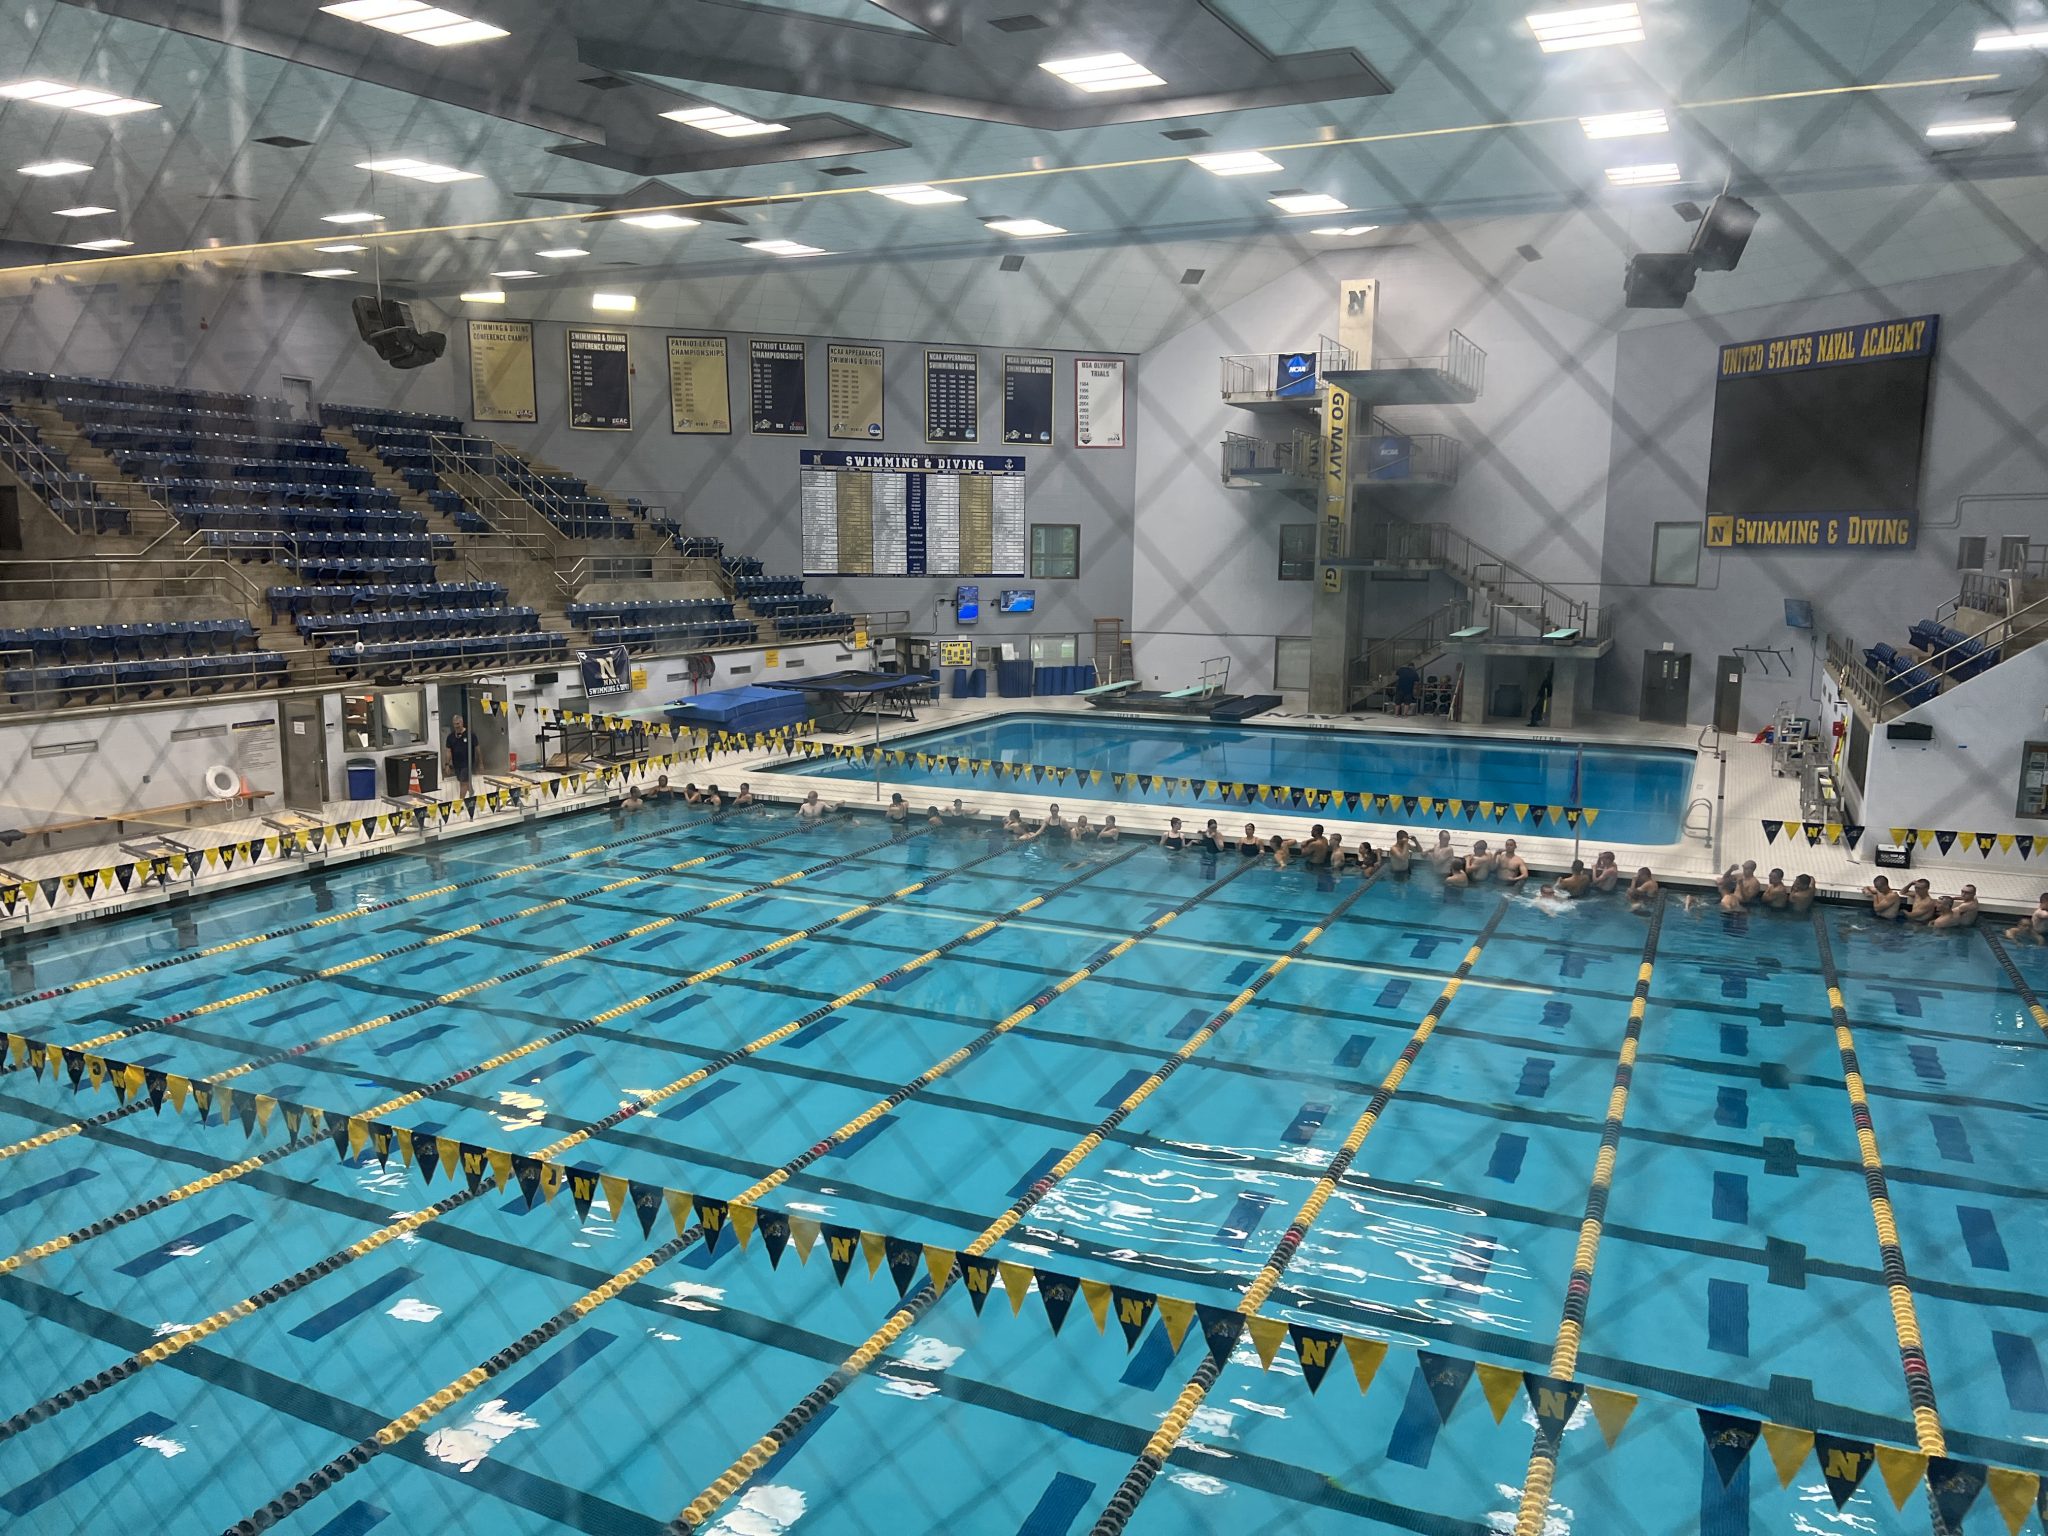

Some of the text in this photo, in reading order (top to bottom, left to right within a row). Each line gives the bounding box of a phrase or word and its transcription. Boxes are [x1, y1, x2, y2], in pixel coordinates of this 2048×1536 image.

[472, 323, 503, 332] SWIMMING
[510, 325, 529, 333] DIVING
[473, 333, 529, 342] CONFERENCE CHAMPS
[571, 332, 601, 341] SWIMMING
[607, 334, 626, 343] DIVING
[571, 342, 626, 352] CONFERENCE CHAMPS
[671, 339, 723, 348] PATRIOT LEAGUE
[752, 342, 803, 351] PATRIOT LEAGUE
[1722, 320, 1927, 376] UNITED STATES NAVAL ACADEMY
[671, 349, 725, 357] CHAMPIONSHIPS
[752, 351, 804, 360] CHAMPIONSHIPS
[845, 349, 882, 358] APPEARANCES
[928, 353, 976, 362] NCAA APPEARANCES
[830, 356, 857, 364] SWIMMING
[1020, 357, 1052, 366] APPEARANCES
[929, 362, 954, 370] SWIMMING
[959, 363, 976, 371] DIVING
[1006, 365, 1031, 373] SWIMMING
[1288, 366, 1307, 374] NCAA
[1331, 392, 1345, 421] GO
[1329, 426, 1344, 481] NAVY
[845, 455, 919, 468] SWIMMING
[924, 458, 932, 468] &
[938, 458, 985, 470] DIVING
[1710, 516, 1910, 546] N SWIMMING & DIVING
[596, 656, 617, 679] N
[603, 678, 620, 686] NAVY
[588, 685, 616, 695] SWIMMING
[1264, 712, 1377, 721] NAVY
[1568, 811, 1577, 821] N
[1807, 827, 1819, 838] N
[1980, 838, 1992, 849] N
[223, 850, 233, 862] N
[155, 863, 165, 875] N
[83, 875, 95, 888] N
[3, 890, 16, 904] N
[91, 1061, 102, 1076] 3
[464, 1153, 484, 1175] N
[573, 1176, 593, 1201] N
[702, 1205, 720, 1231] N
[831, 1236, 851, 1262] N
[967, 1265, 989, 1293] N
[1120, 1298, 1146, 1327] N
[1300, 1336, 1327, 1367] N
[1536, 1388, 1568, 1420] N
[1825, 1450, 1861, 1481] N
